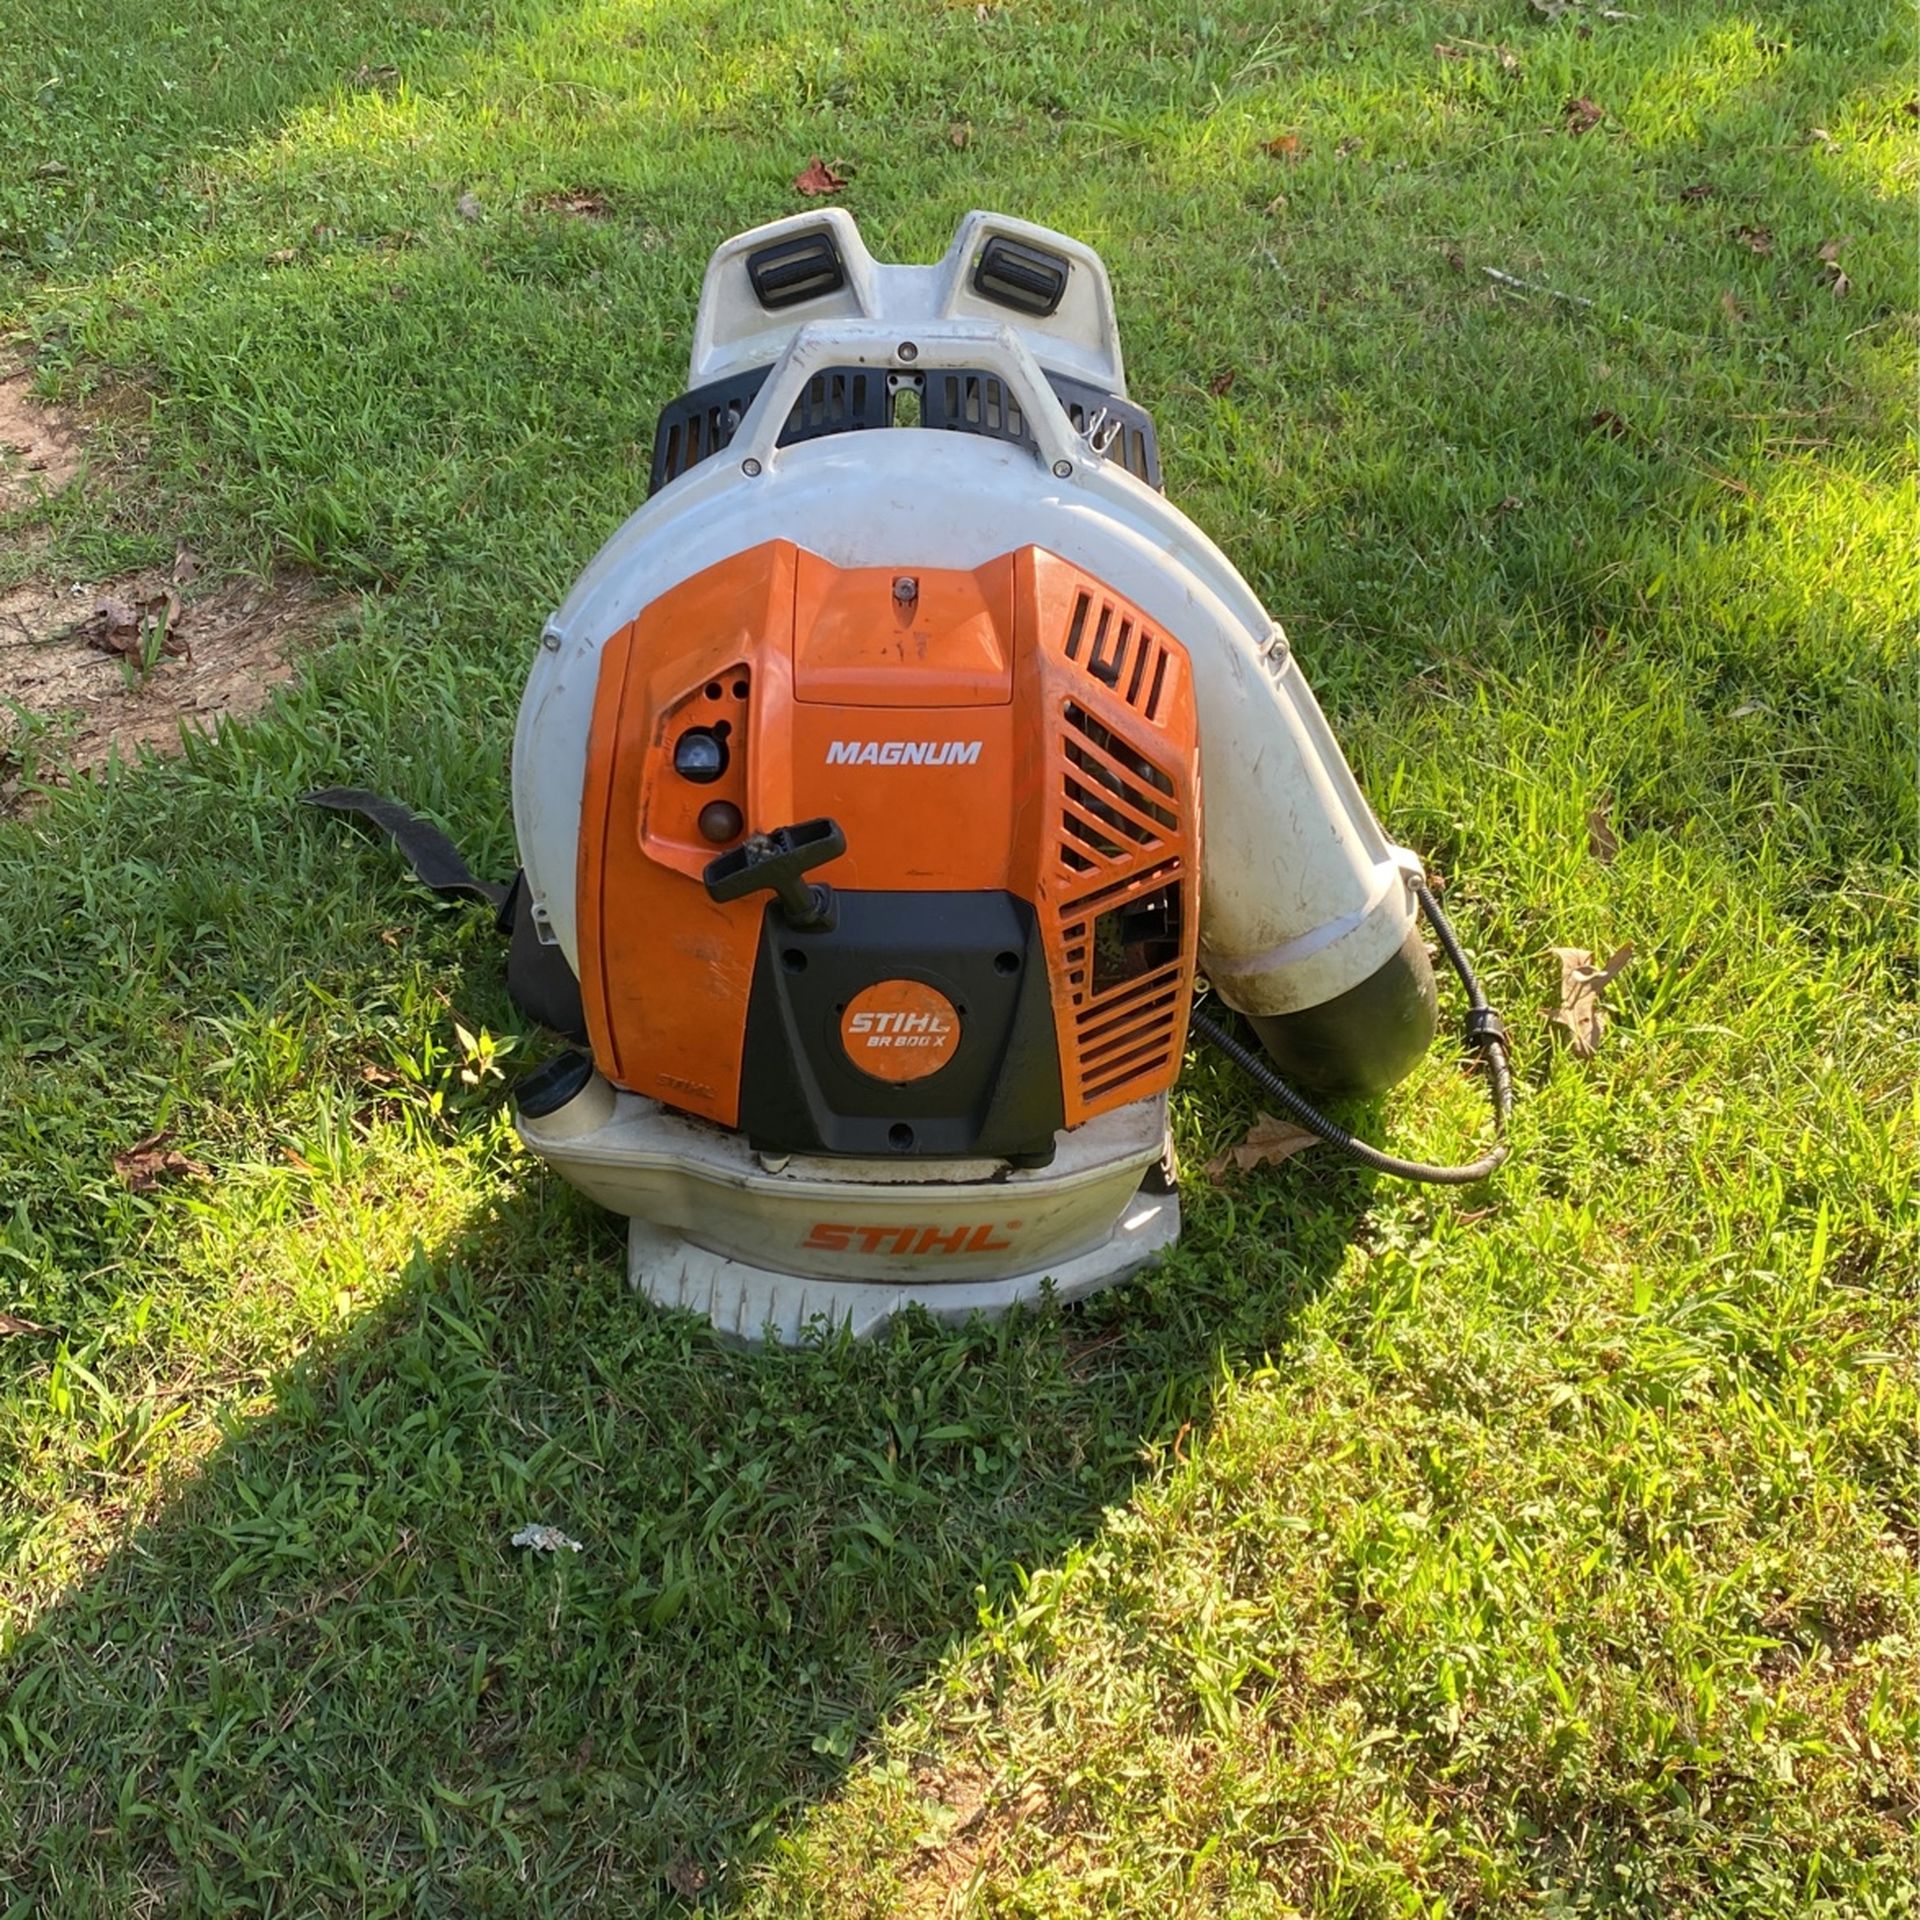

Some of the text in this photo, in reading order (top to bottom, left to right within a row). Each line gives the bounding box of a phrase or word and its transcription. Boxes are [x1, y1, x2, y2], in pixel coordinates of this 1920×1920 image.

[825, 741, 983, 765] MAGNUM
[848, 1012, 951, 1033] STIHL
[866, 1036, 946, 1047] BR 800 X
